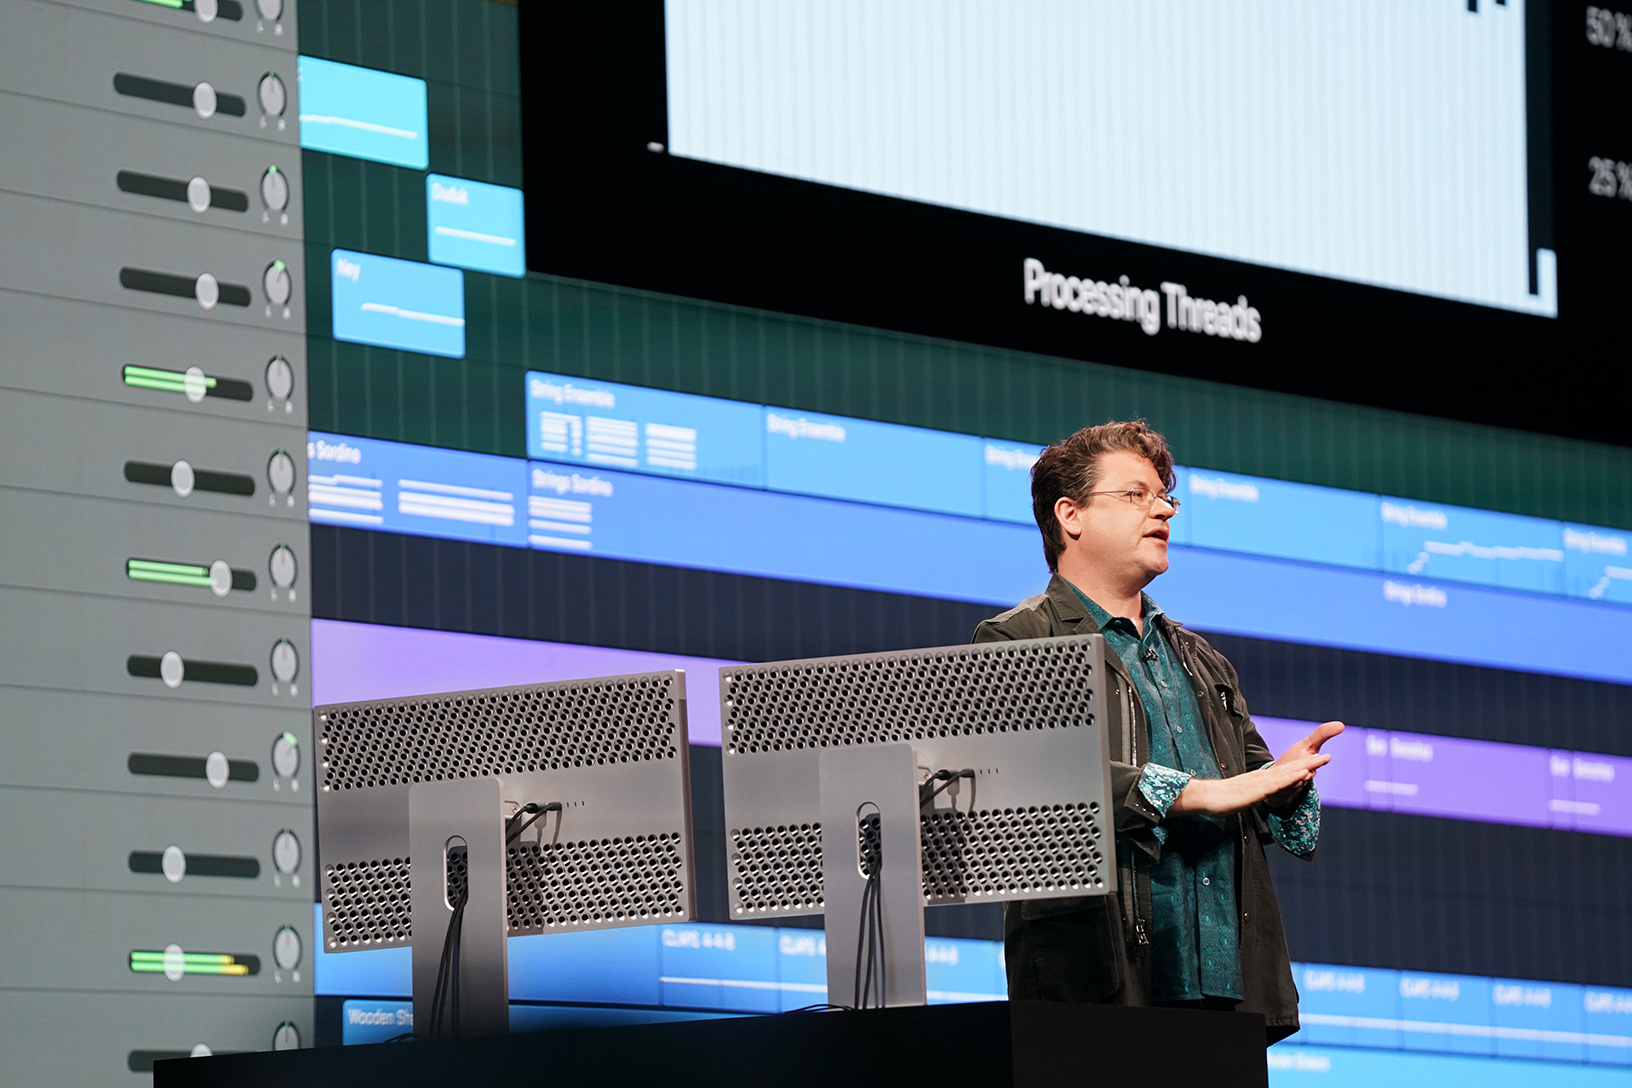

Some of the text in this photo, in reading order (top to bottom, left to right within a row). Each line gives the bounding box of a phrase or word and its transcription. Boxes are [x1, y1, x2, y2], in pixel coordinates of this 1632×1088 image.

[1023, 257, 1262, 343] Processing Threads
[347, 1008, 395, 1026] Wooden
